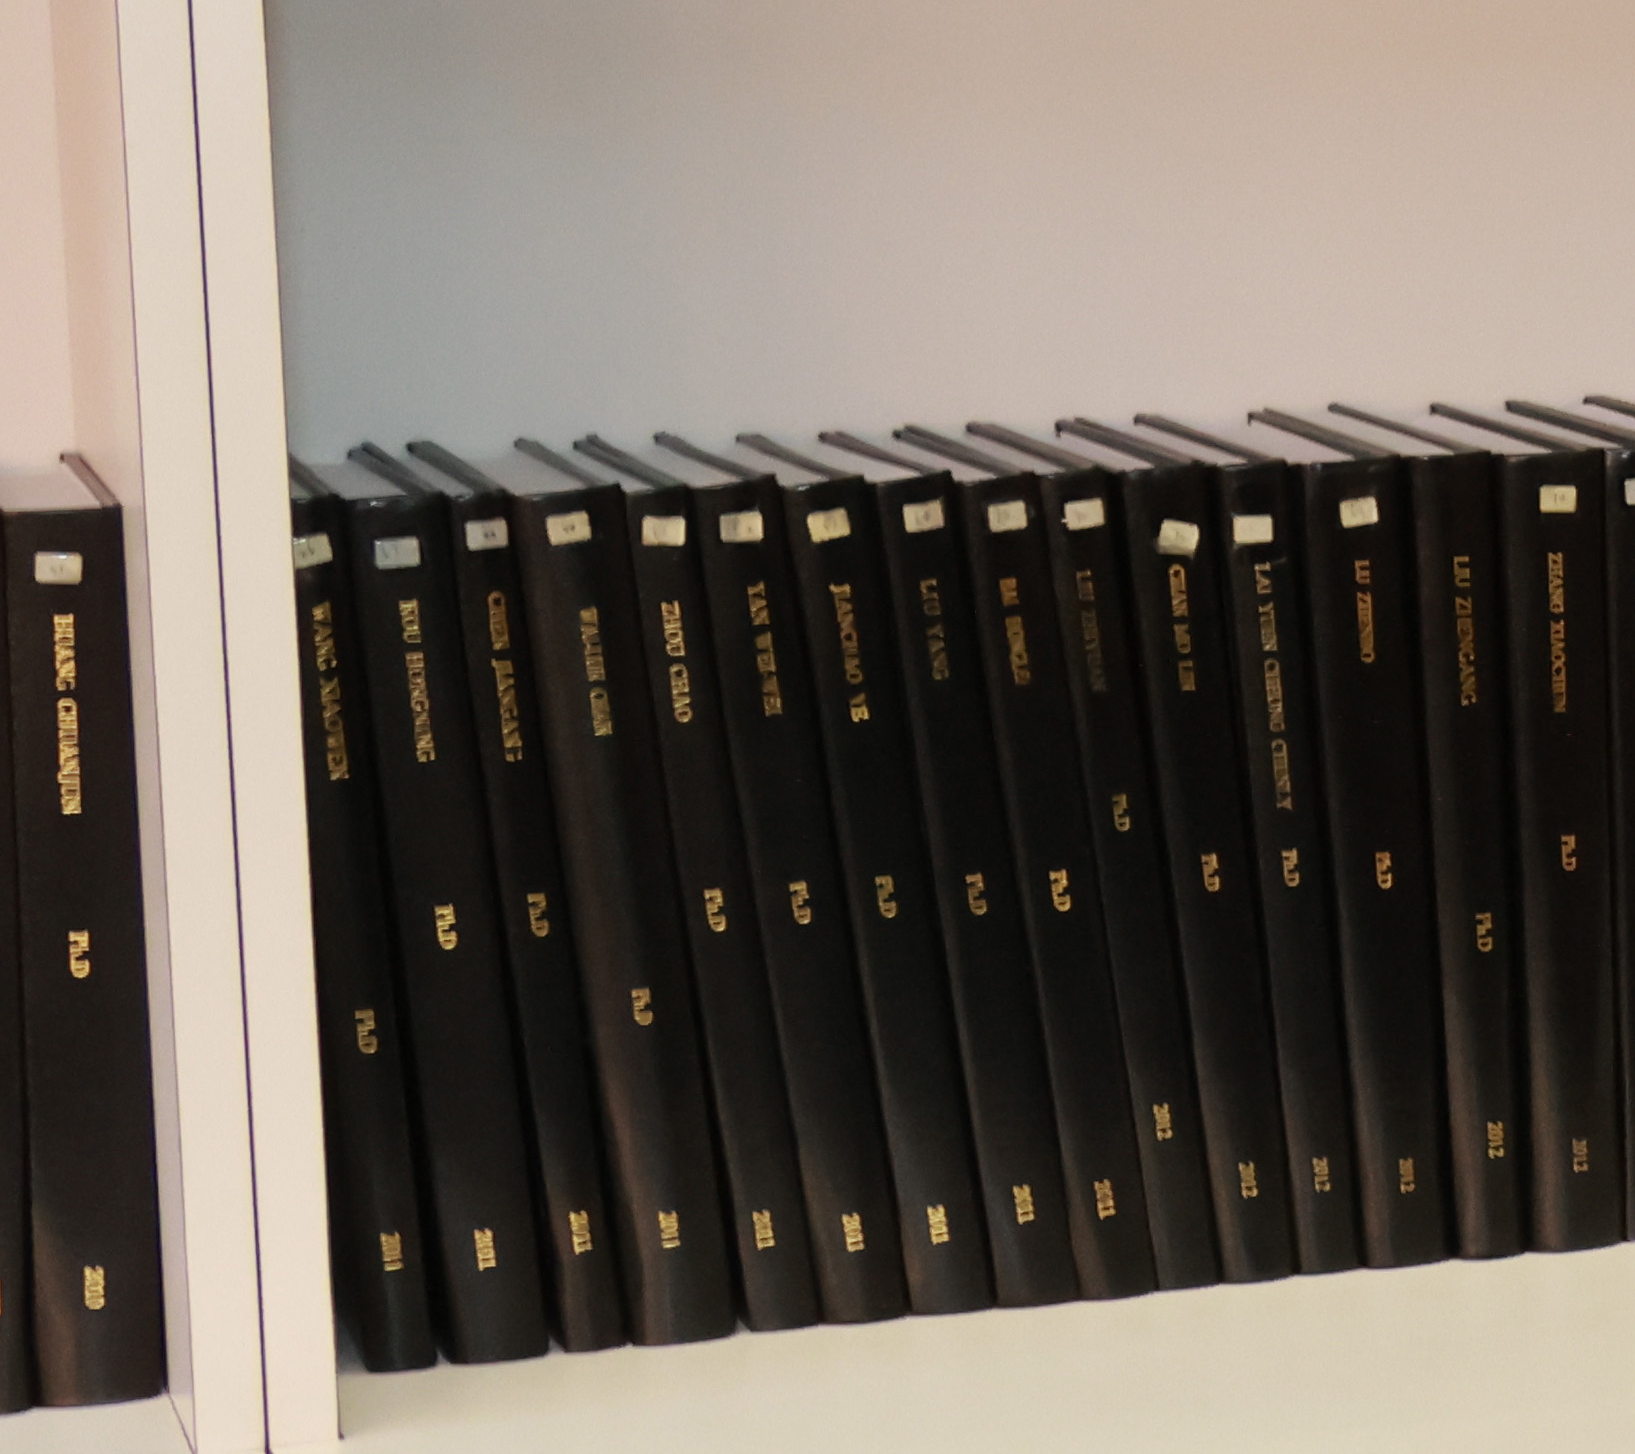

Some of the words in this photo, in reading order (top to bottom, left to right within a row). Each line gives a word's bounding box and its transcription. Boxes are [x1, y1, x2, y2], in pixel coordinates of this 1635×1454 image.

[920, 578, 941, 615] LIU
[660, 600, 686, 657] ZHOU
[927, 624, 949, 680] YANG
[669, 663, 693, 723] CHAO
[1547, 552, 1565, 614] ZHANG
[1561, 834, 1577, 871] Ph.D
[1254, 562, 1273, 594] LAI
[1281, 848, 1300, 887] Ph.D
[747, 581, 770, 625] YAN
[788, 880, 812, 925] Ph.D
[52, 613, 77, 691] HUANG
[67, 929, 91, 979] Ph.D
[312, 601, 337, 671] WANG
[355, 1009, 378, 1054] Ph.D
[1201, 852, 1221, 892] Ph.D
[1375, 851, 1394, 890] Ph.D
[1453, 555, 1471, 587] LIU
[1475, 912, 1494, 952] Ph.D
[1487, 1121, 1505, 1159] 2012
[526, 893, 550, 937] Ph.D
[703, 887, 728, 933] Ph.D
[875, 875, 898, 918] Ph.D
[965, 872, 988, 915] Ph.D
[1049, 868, 1072, 912] Ph.D
[434, 903, 458, 950] Ph.D
